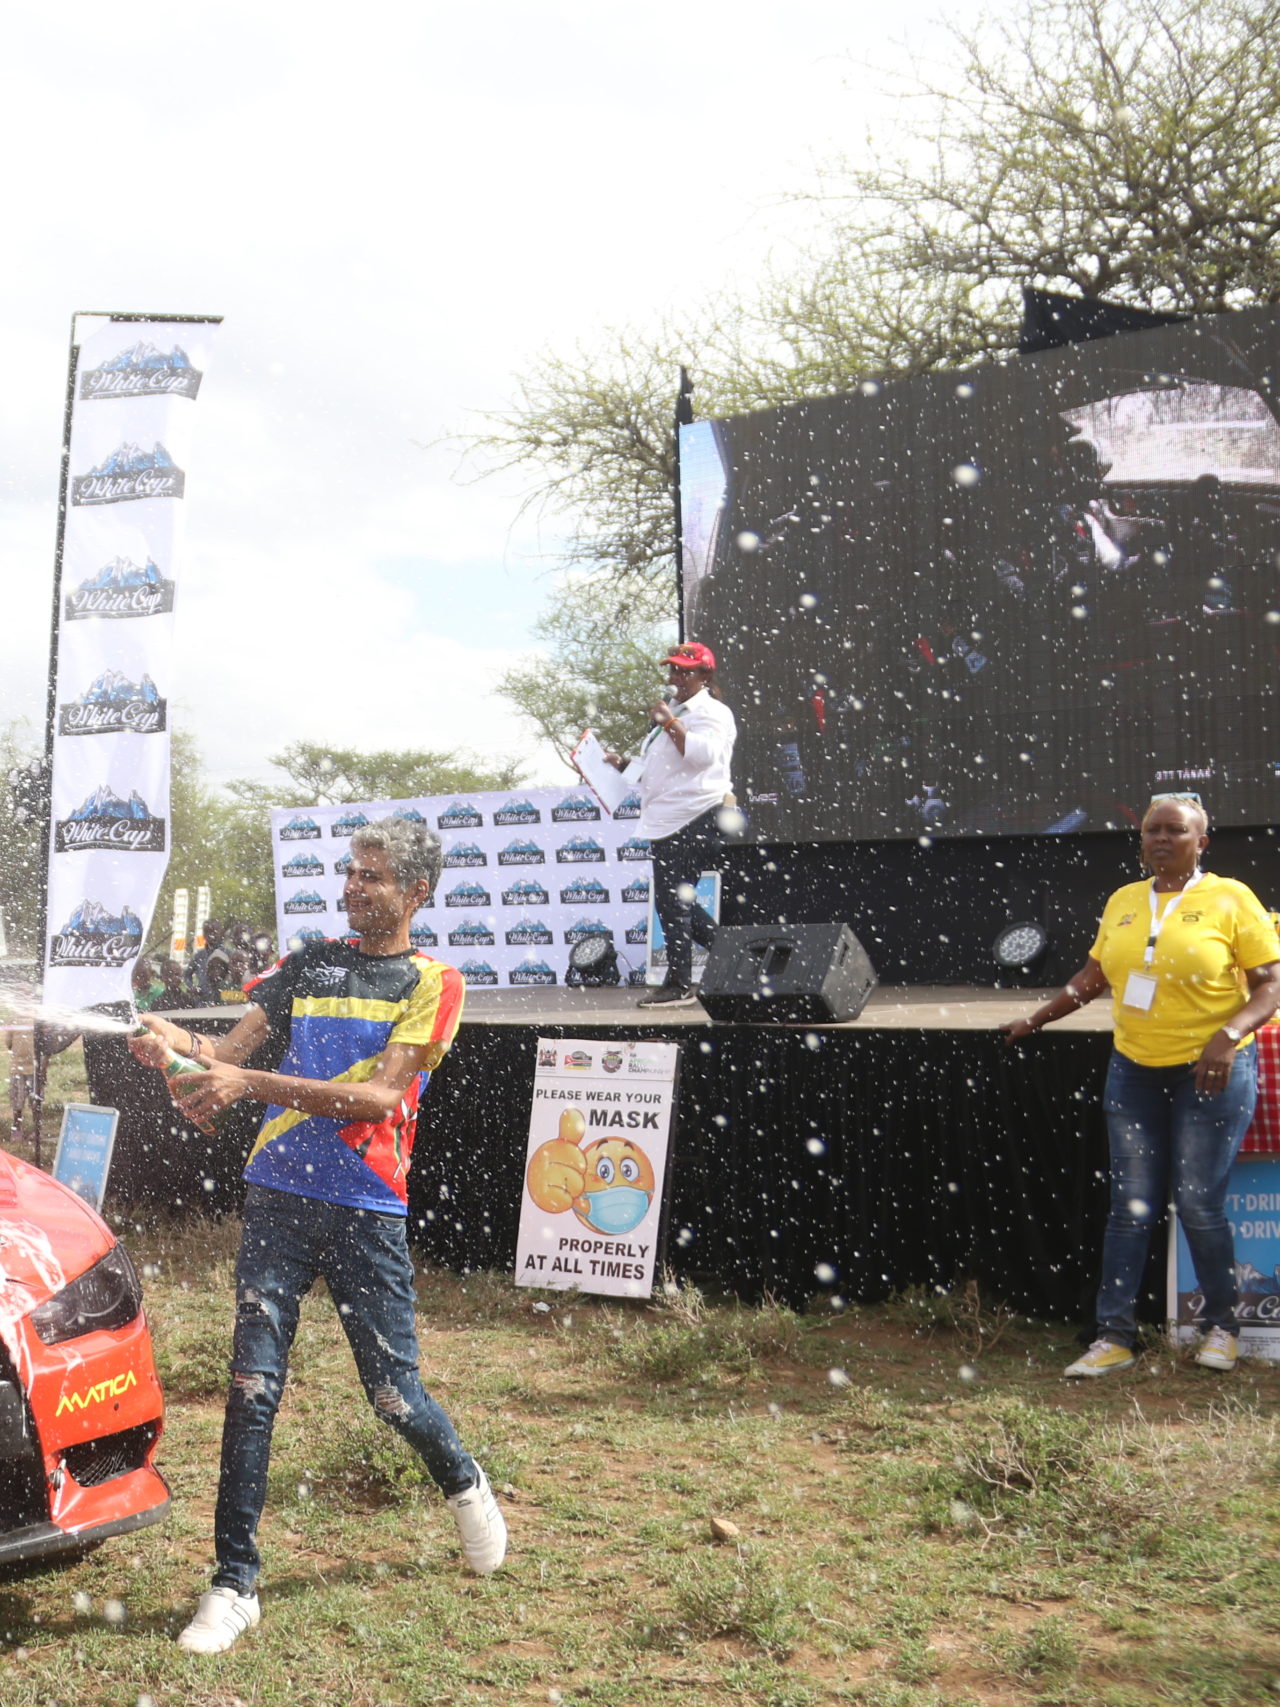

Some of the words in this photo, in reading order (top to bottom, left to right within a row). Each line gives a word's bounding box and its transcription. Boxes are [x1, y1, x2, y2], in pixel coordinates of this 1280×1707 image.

[90, 371, 148, 391] White
[149, 370, 189, 392] Cap
[81, 476, 135, 497] White
[135, 470, 173, 495] Cap
[72, 591, 130, 610] White
[132, 586, 162, 614] Cap
[69, 705, 120, 725] White
[121, 702, 159, 730] Cap
[497, 812, 520, 823] White
[520, 811, 537, 823] Cap
[63, 822, 108, 842] White
[109, 820, 151, 849] Cap
[448, 895, 470, 905] White
[470, 894, 486, 906] Cap
[56, 935, 102, 957] White
[452, 934, 474, 944] White
[474, 933, 491, 945] Cap
[536, 1089, 582, 1101] PLEASE
[586, 1091, 621, 1102] WEAR
[626, 1093, 662, 1104] YOUR
[589, 1108, 660, 1129] MASK
[559, 1237, 649, 1259] PROPERLY
[524, 1254, 547, 1270] AT
[551, 1256, 583, 1274] ALL
[589, 1260, 645, 1280] TIMES
[55, 1370, 137, 1417] MATICA
